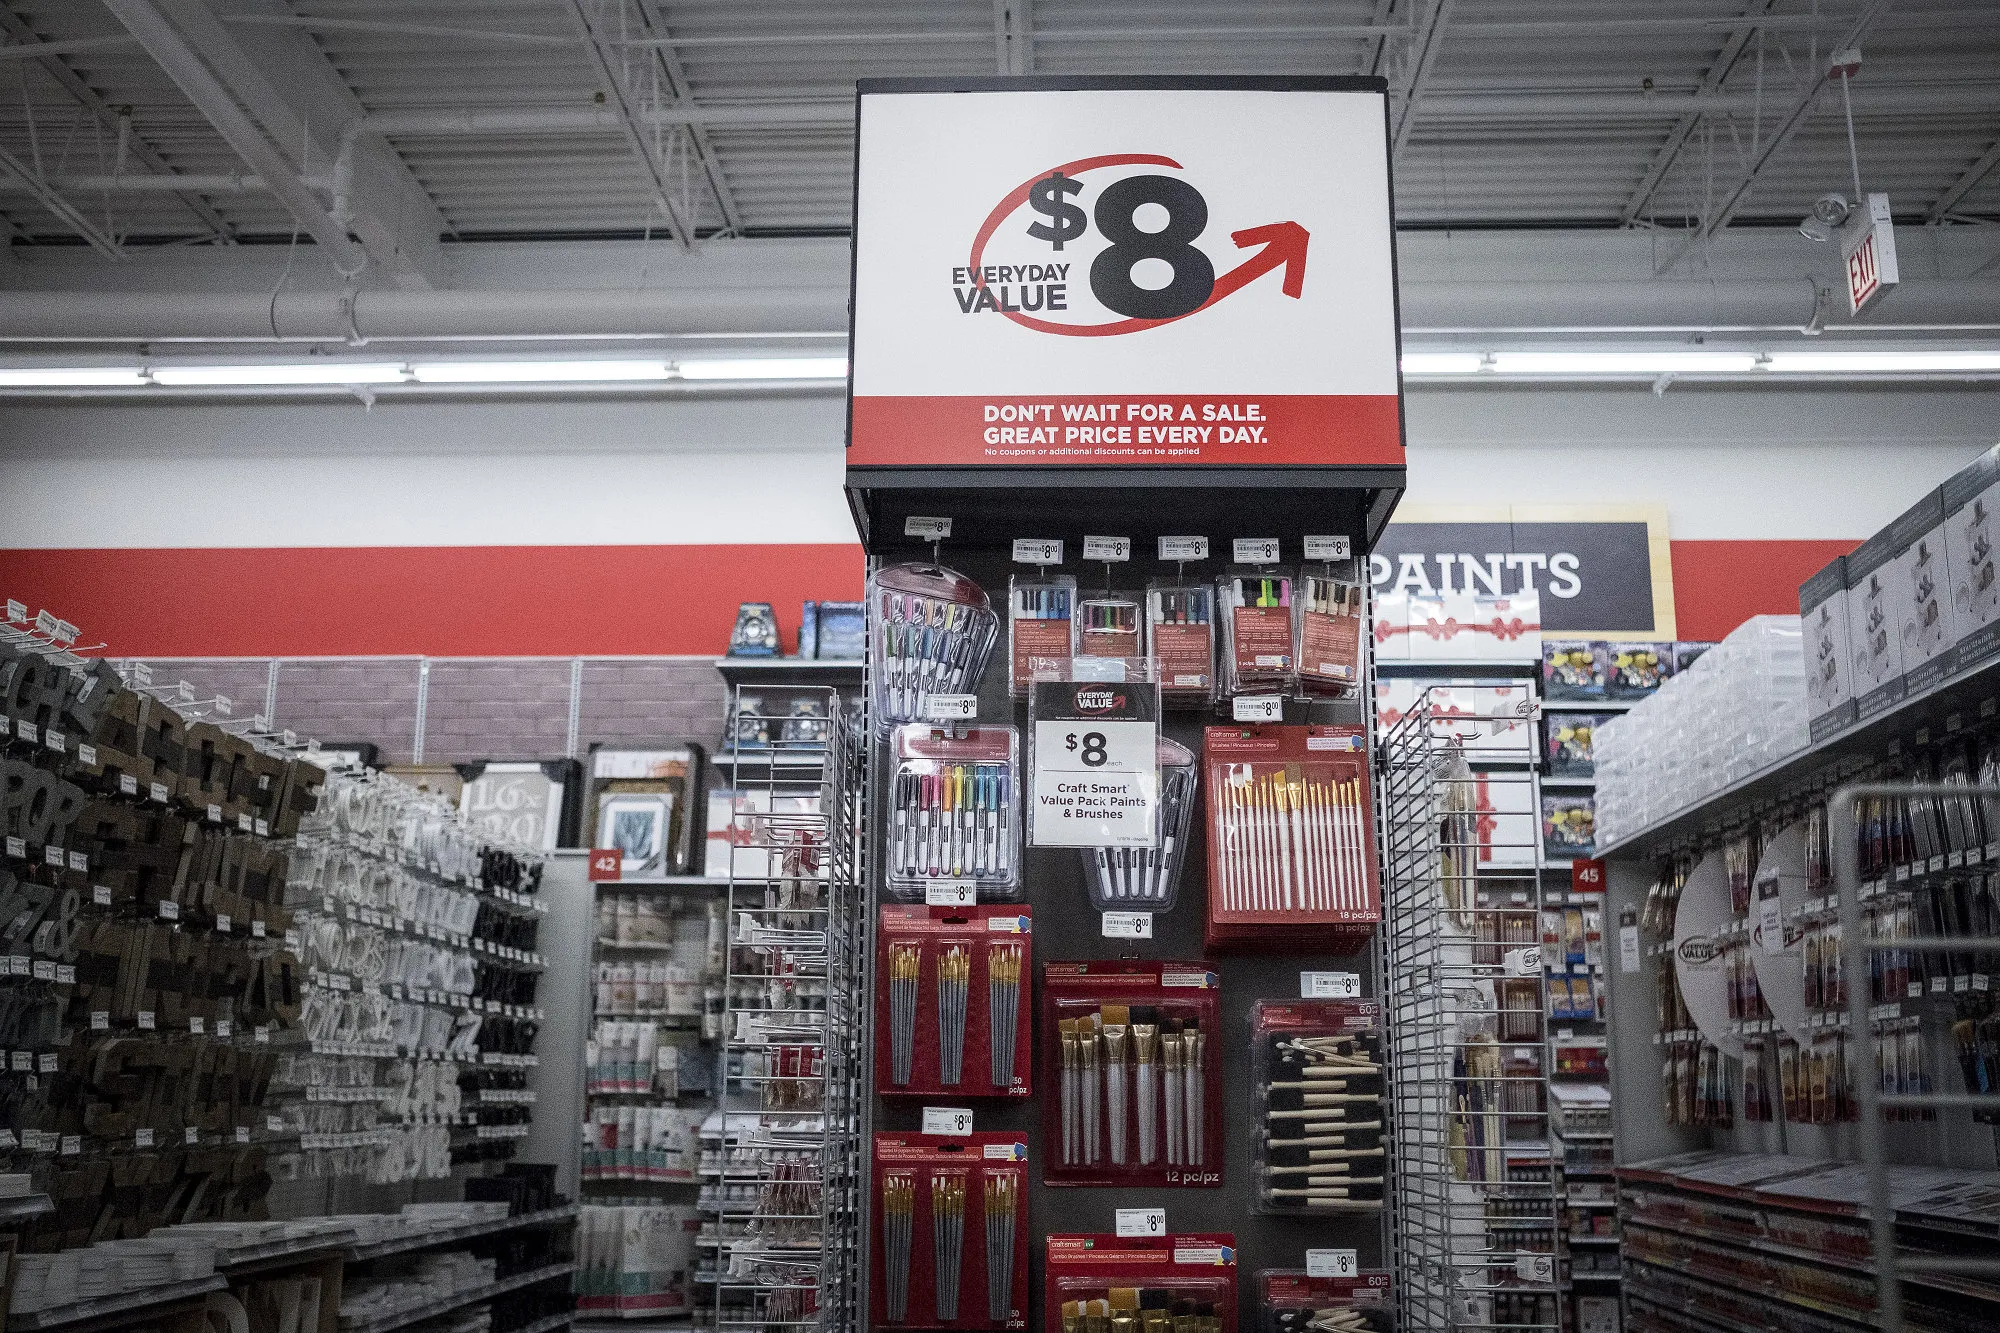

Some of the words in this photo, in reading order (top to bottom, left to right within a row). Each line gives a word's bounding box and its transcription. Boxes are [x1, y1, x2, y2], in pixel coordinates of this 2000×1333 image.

[1026, 172, 1215, 319] $8
[1849, 234, 1876, 297] EXIT
[952, 263, 1071, 285] EVERYDAY
[953, 284, 1067, 314] VALUE
[983, 404, 1055, 422] DON'T
[1060, 404, 1120, 422] WAIT
[1127, 404, 1174, 421] FOR
[1179, 404, 1197, 421] A
[1202, 404, 1267, 422] SALE.
[983, 427, 1059, 444] GREAT
[1065, 427, 1132, 444] PRICE
[1138, 426, 1213, 444] EVERY
[1218, 426, 1268, 444] DAY.
[999, 449, 1036, 457] coupons
[1168, 448, 1200, 457] applied
[1370, 553, 1582, 599] PAINTS
[1077, 699, 1113, 709] VALUE
[1065, 731, 1108, 767] $8
[1057, 783, 1087, 793] Craft
[1091, 783, 1127, 794] Smart
[1040, 796, 1074, 806] Value
[1078, 796, 1106, 806] Pack
[1110, 796, 1146, 807] Paints
[1063, 809, 1072, 818] &
[1075, 809, 1123, 819] Brushes
[595, 857, 616, 872] 42
[1578, 868, 1599, 883] 45
[1339, 911, 1349, 919] 18
[1351, 911, 1377, 921] pc/pz
[1335, 924, 1344, 932] 18
[1345, 924, 1371, 934] pc/pz
[1683, 949, 1714, 958] VALUE
[1359, 1005, 1372, 1015] 60
[1013, 1076, 1022, 1084] 50
[1008, 1085, 1027, 1095] pc/pz
[1165, 1171, 1179, 1182] 12
[1183, 1170, 1219, 1183] pc/pz
[1368, 1276, 1382, 1286] 60
[1011, 1309, 1020, 1317] 50
[1006, 1318, 1025, 1328] pc/pz
